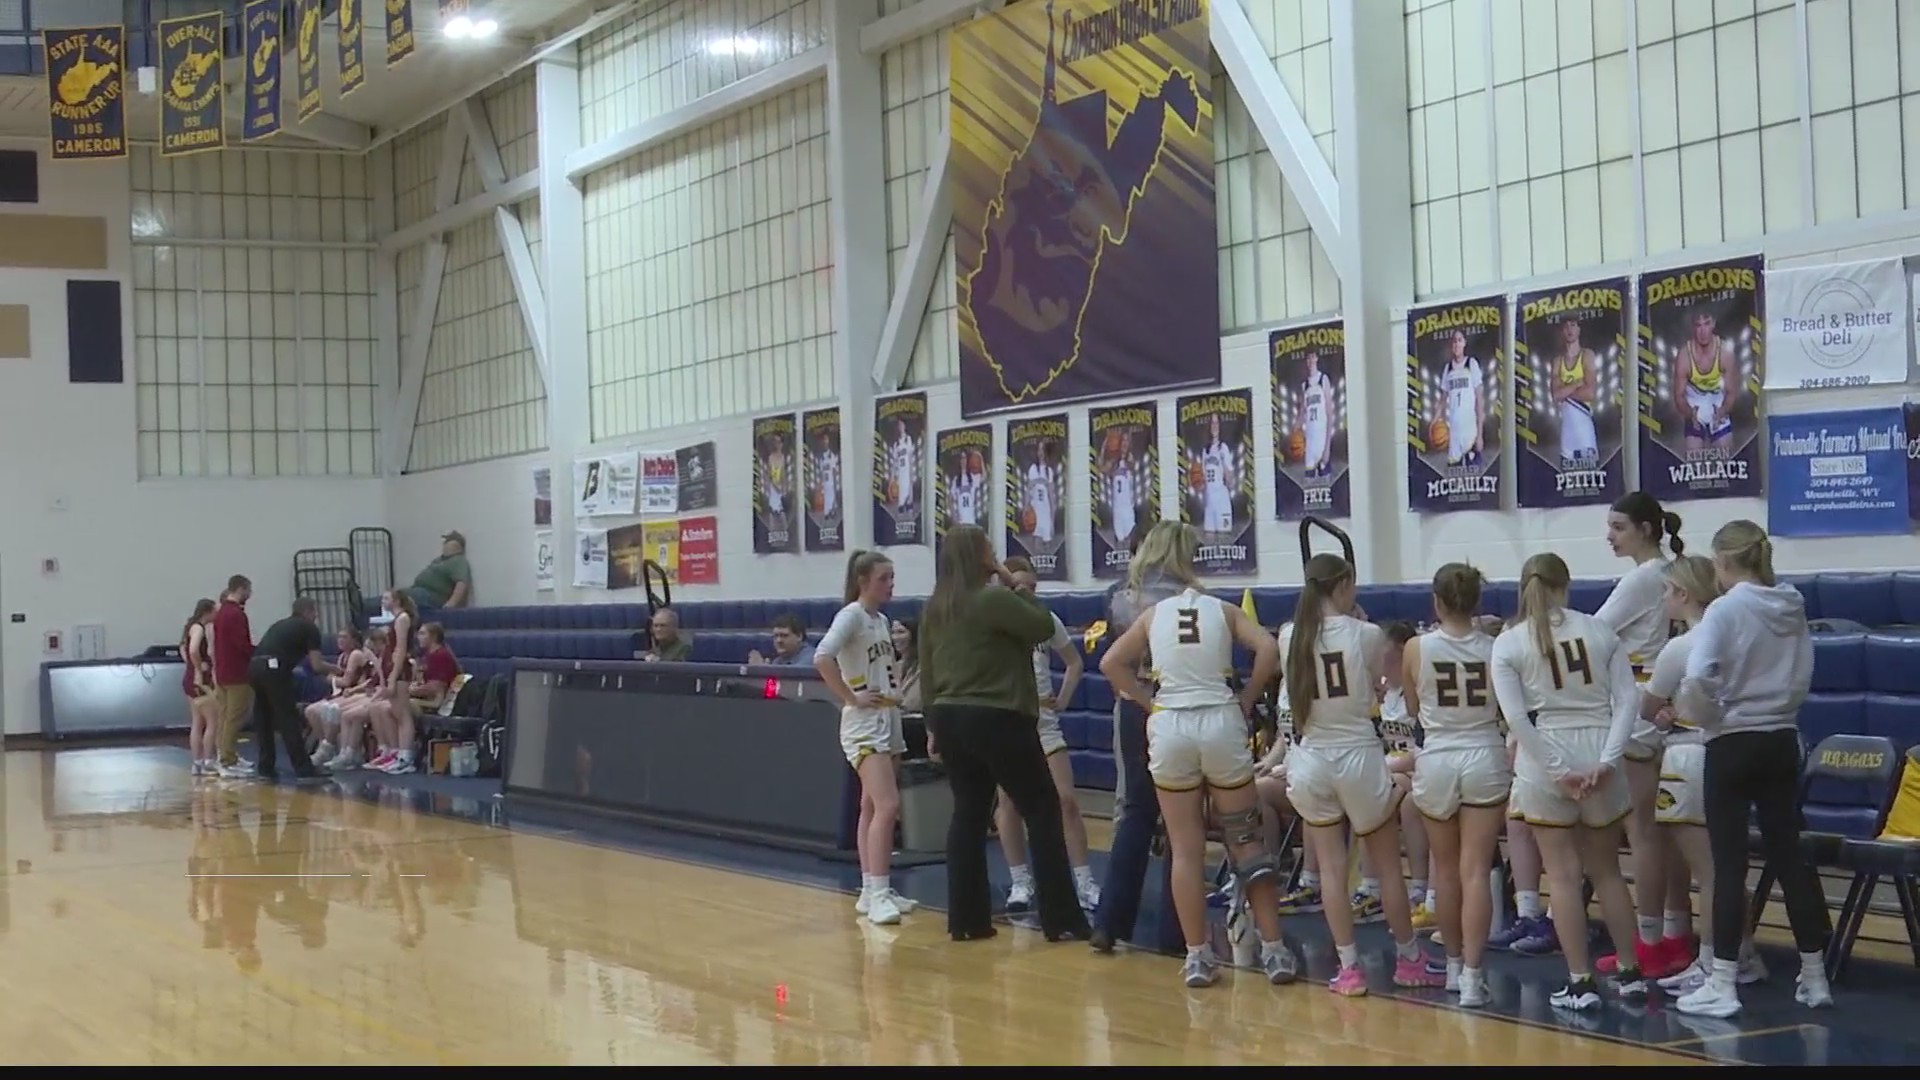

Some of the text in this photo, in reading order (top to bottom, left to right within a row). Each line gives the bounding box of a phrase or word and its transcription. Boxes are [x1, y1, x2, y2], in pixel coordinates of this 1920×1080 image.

[49, 34, 88, 60] STATE
[166, 24, 215, 49] OVER-ALL
[52, 80, 121, 119] RUNNER-UP
[55, 138, 120, 153] CAMERON
[166, 128, 219, 148] CAMERON
[1647, 268, 1756, 306] DRAGONS
[1523, 288, 1622, 323] DRAGONS
[1414, 305, 1500, 338] DRAGONS
[1782, 311, 1893, 333] Bread & Butter
[1275, 328, 1344, 358] DRAGONS
[1821, 328, 1852, 346] Deli
[1092, 408, 1152, 431] DRAGONS
[1181, 397, 1248, 422] DRAGONS
[941, 431, 990, 452] DRAGONS
[1012, 421, 1065, 444] DRAGONS
[1773, 432, 1820, 456] Panhandle
[1820, 429, 1857, 454] Farmers
[1858, 426, 1891, 452] Mutual
[1555, 470, 1608, 491] PETTIT
[1668, 460, 1749, 484] WALLACE
[1303, 487, 1333, 505] FRYE
[1427, 475, 1498, 498] MCCAULEY
[1861, 487, 1881, 498] WV
[1177, 608, 1200, 644] 3
[1548, 638, 1592, 691] 14
[1432, 661, 1487, 707] 22
[1819, 749, 1885, 769] DRAGONS
